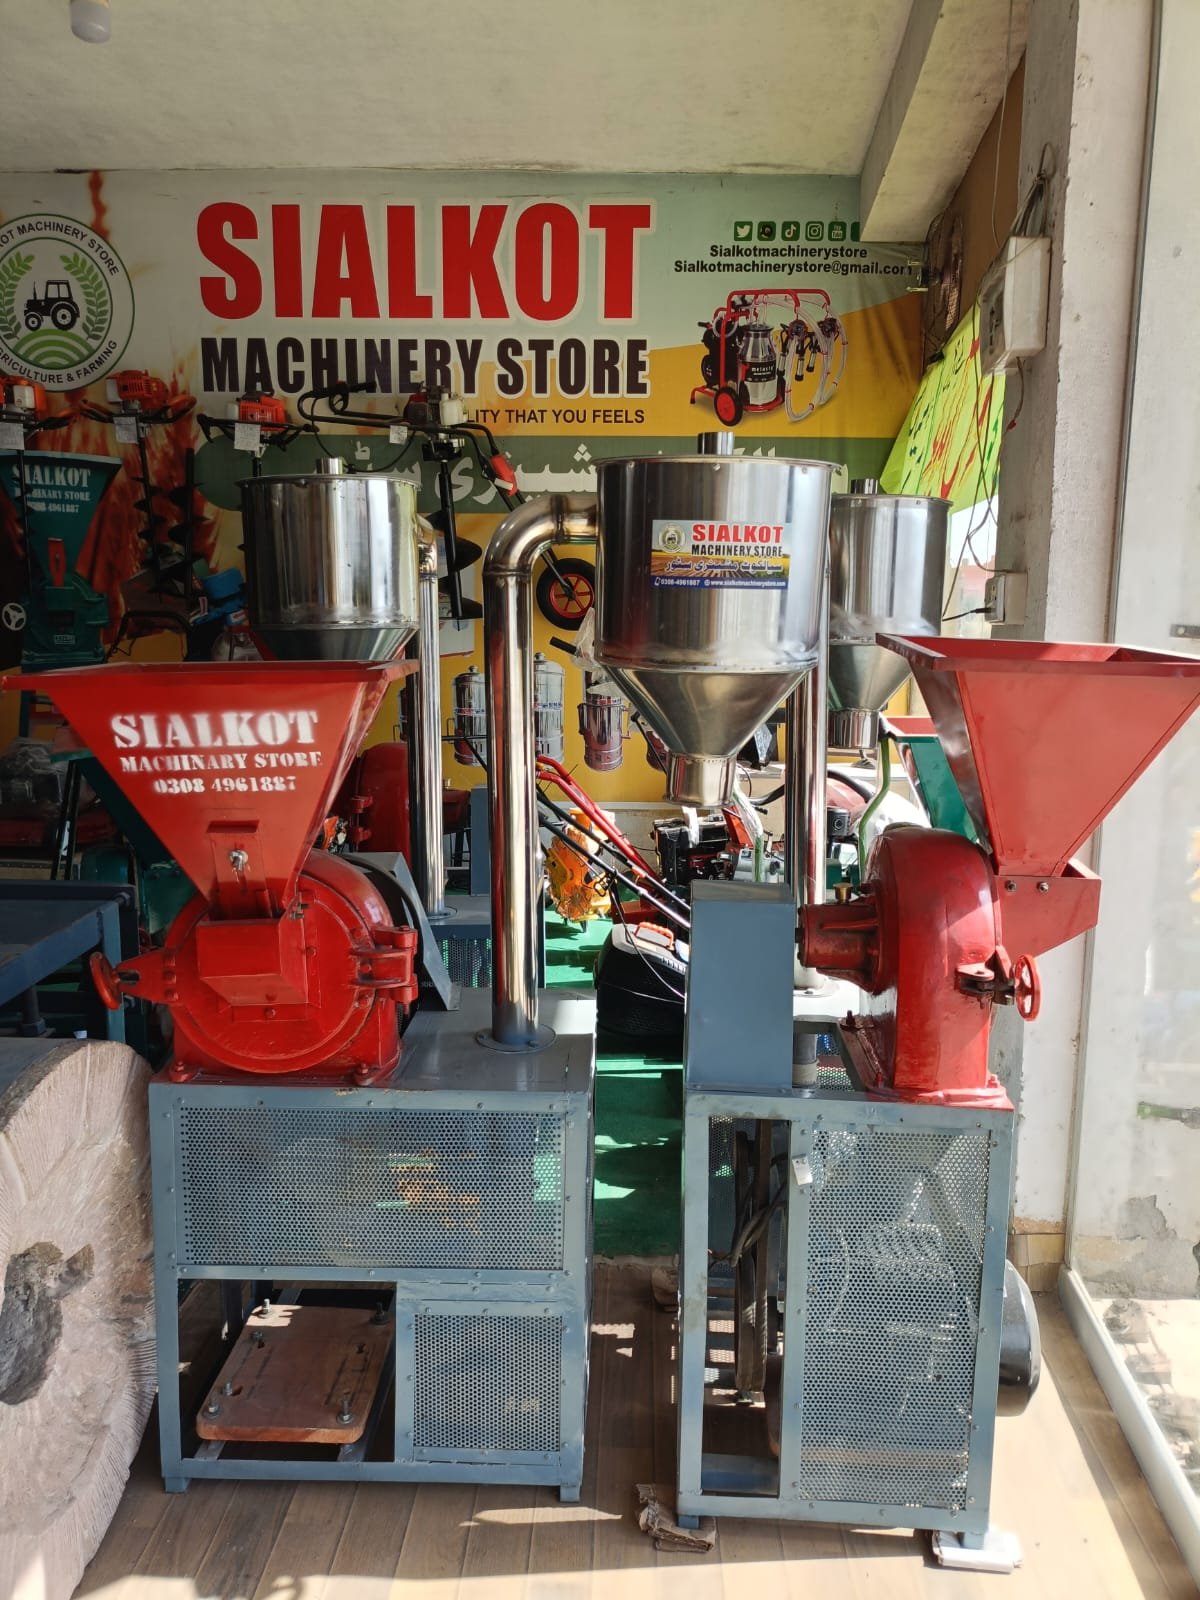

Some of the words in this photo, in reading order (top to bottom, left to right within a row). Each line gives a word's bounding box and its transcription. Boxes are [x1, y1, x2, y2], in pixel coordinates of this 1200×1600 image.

[16, 221, 88, 242] MACHINERY
[87, 238, 120, 276] STORE
[709, 244, 868, 261] Sialkotmachinerystore
[197, 202, 651, 320] SIALKOT
[66, 371, 75, 382] &
[77, 339, 118, 380] FARMING
[200, 336, 483, 395] MACHINERY
[496, 337, 648, 395] STORE
[467, 409, 501, 424] LITY
[505, 409, 548, 424] THAT
[552, 409, 587, 424] YOU
[592, 409, 646, 424] FEELS
[692, 524, 784, 543] SIALKOT
[691, 544, 751, 556] MACHINERY
[754, 545, 783, 557] STORE
[110, 709, 319, 749] SIALKOT
[119, 752, 248, 772] MACHINARY
[253, 751, 322, 769] STORE
[153, 776, 205, 794] 0308
[211, 775, 297, 793] 4961887
